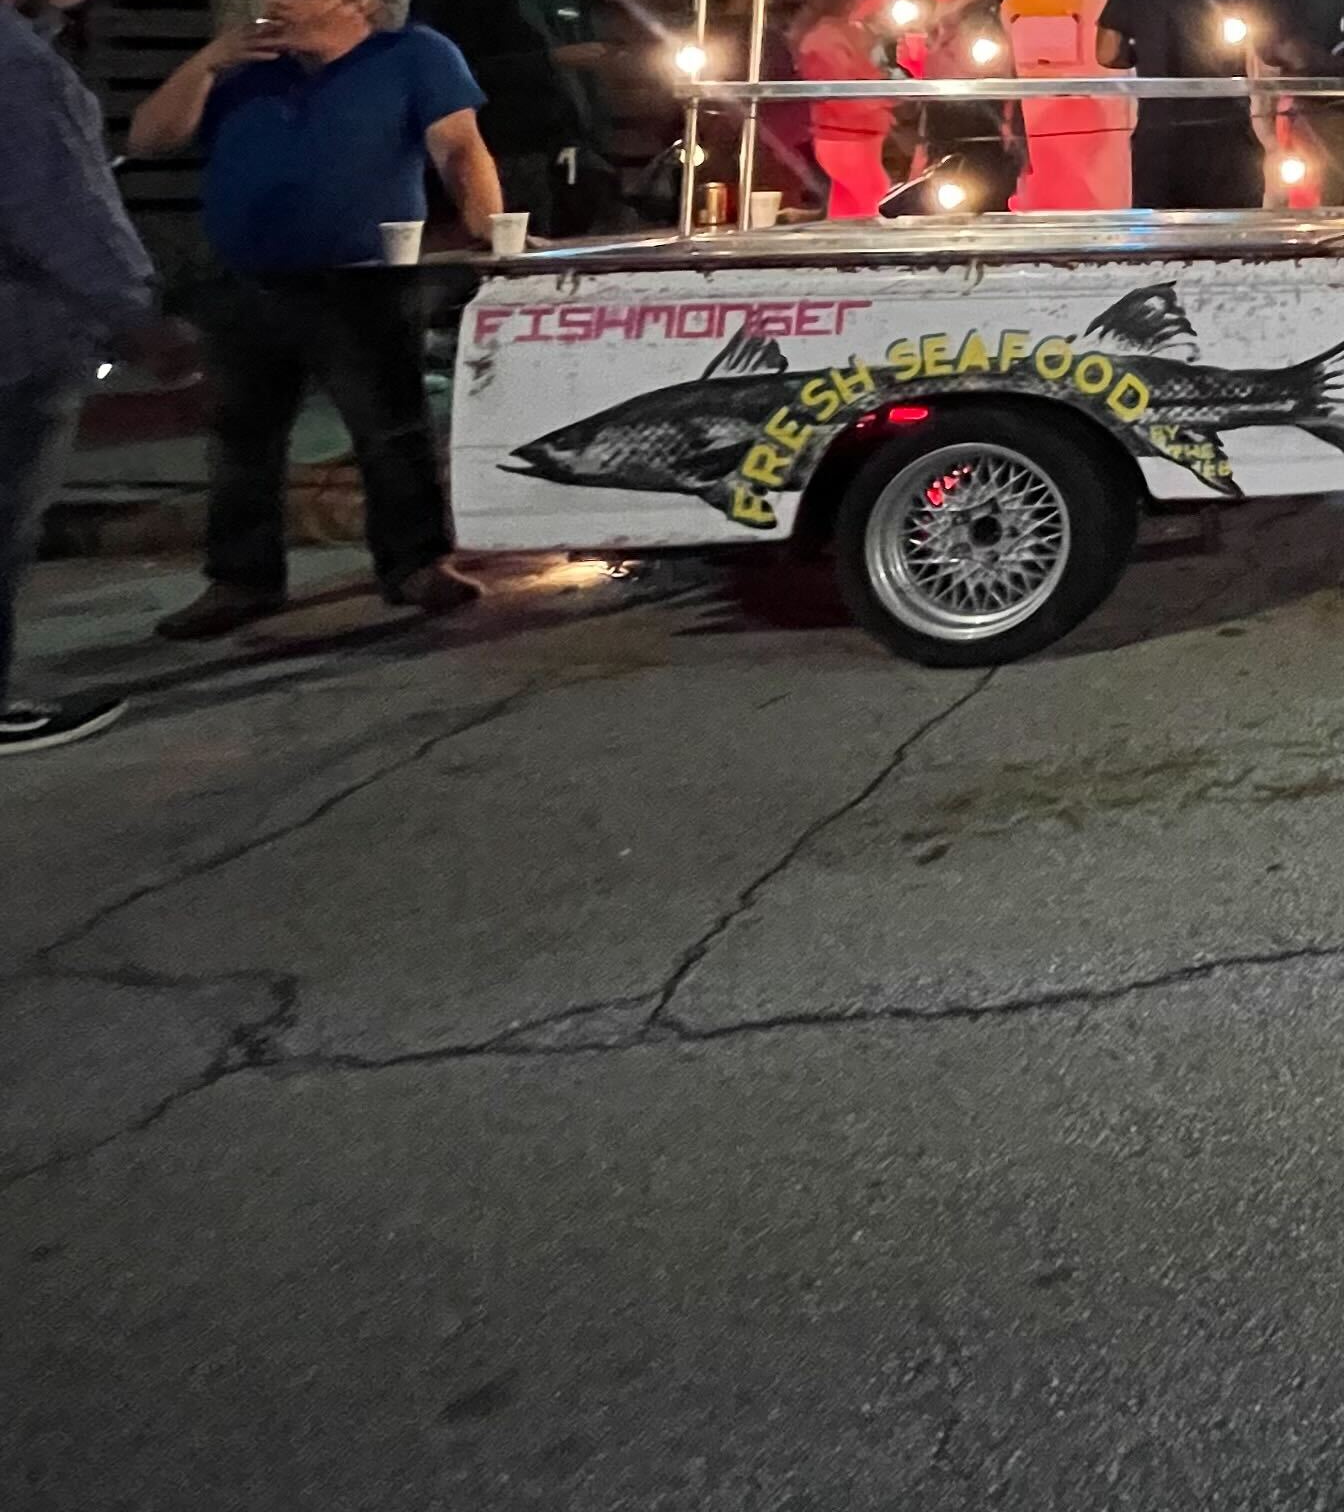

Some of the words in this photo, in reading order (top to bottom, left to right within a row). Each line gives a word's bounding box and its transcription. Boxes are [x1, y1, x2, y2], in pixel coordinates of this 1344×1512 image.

[474, 300, 872, 343] FISHMONGER
[731, 355, 876, 523] FRESH
[886, 330, 1150, 422] SEAFOOD
